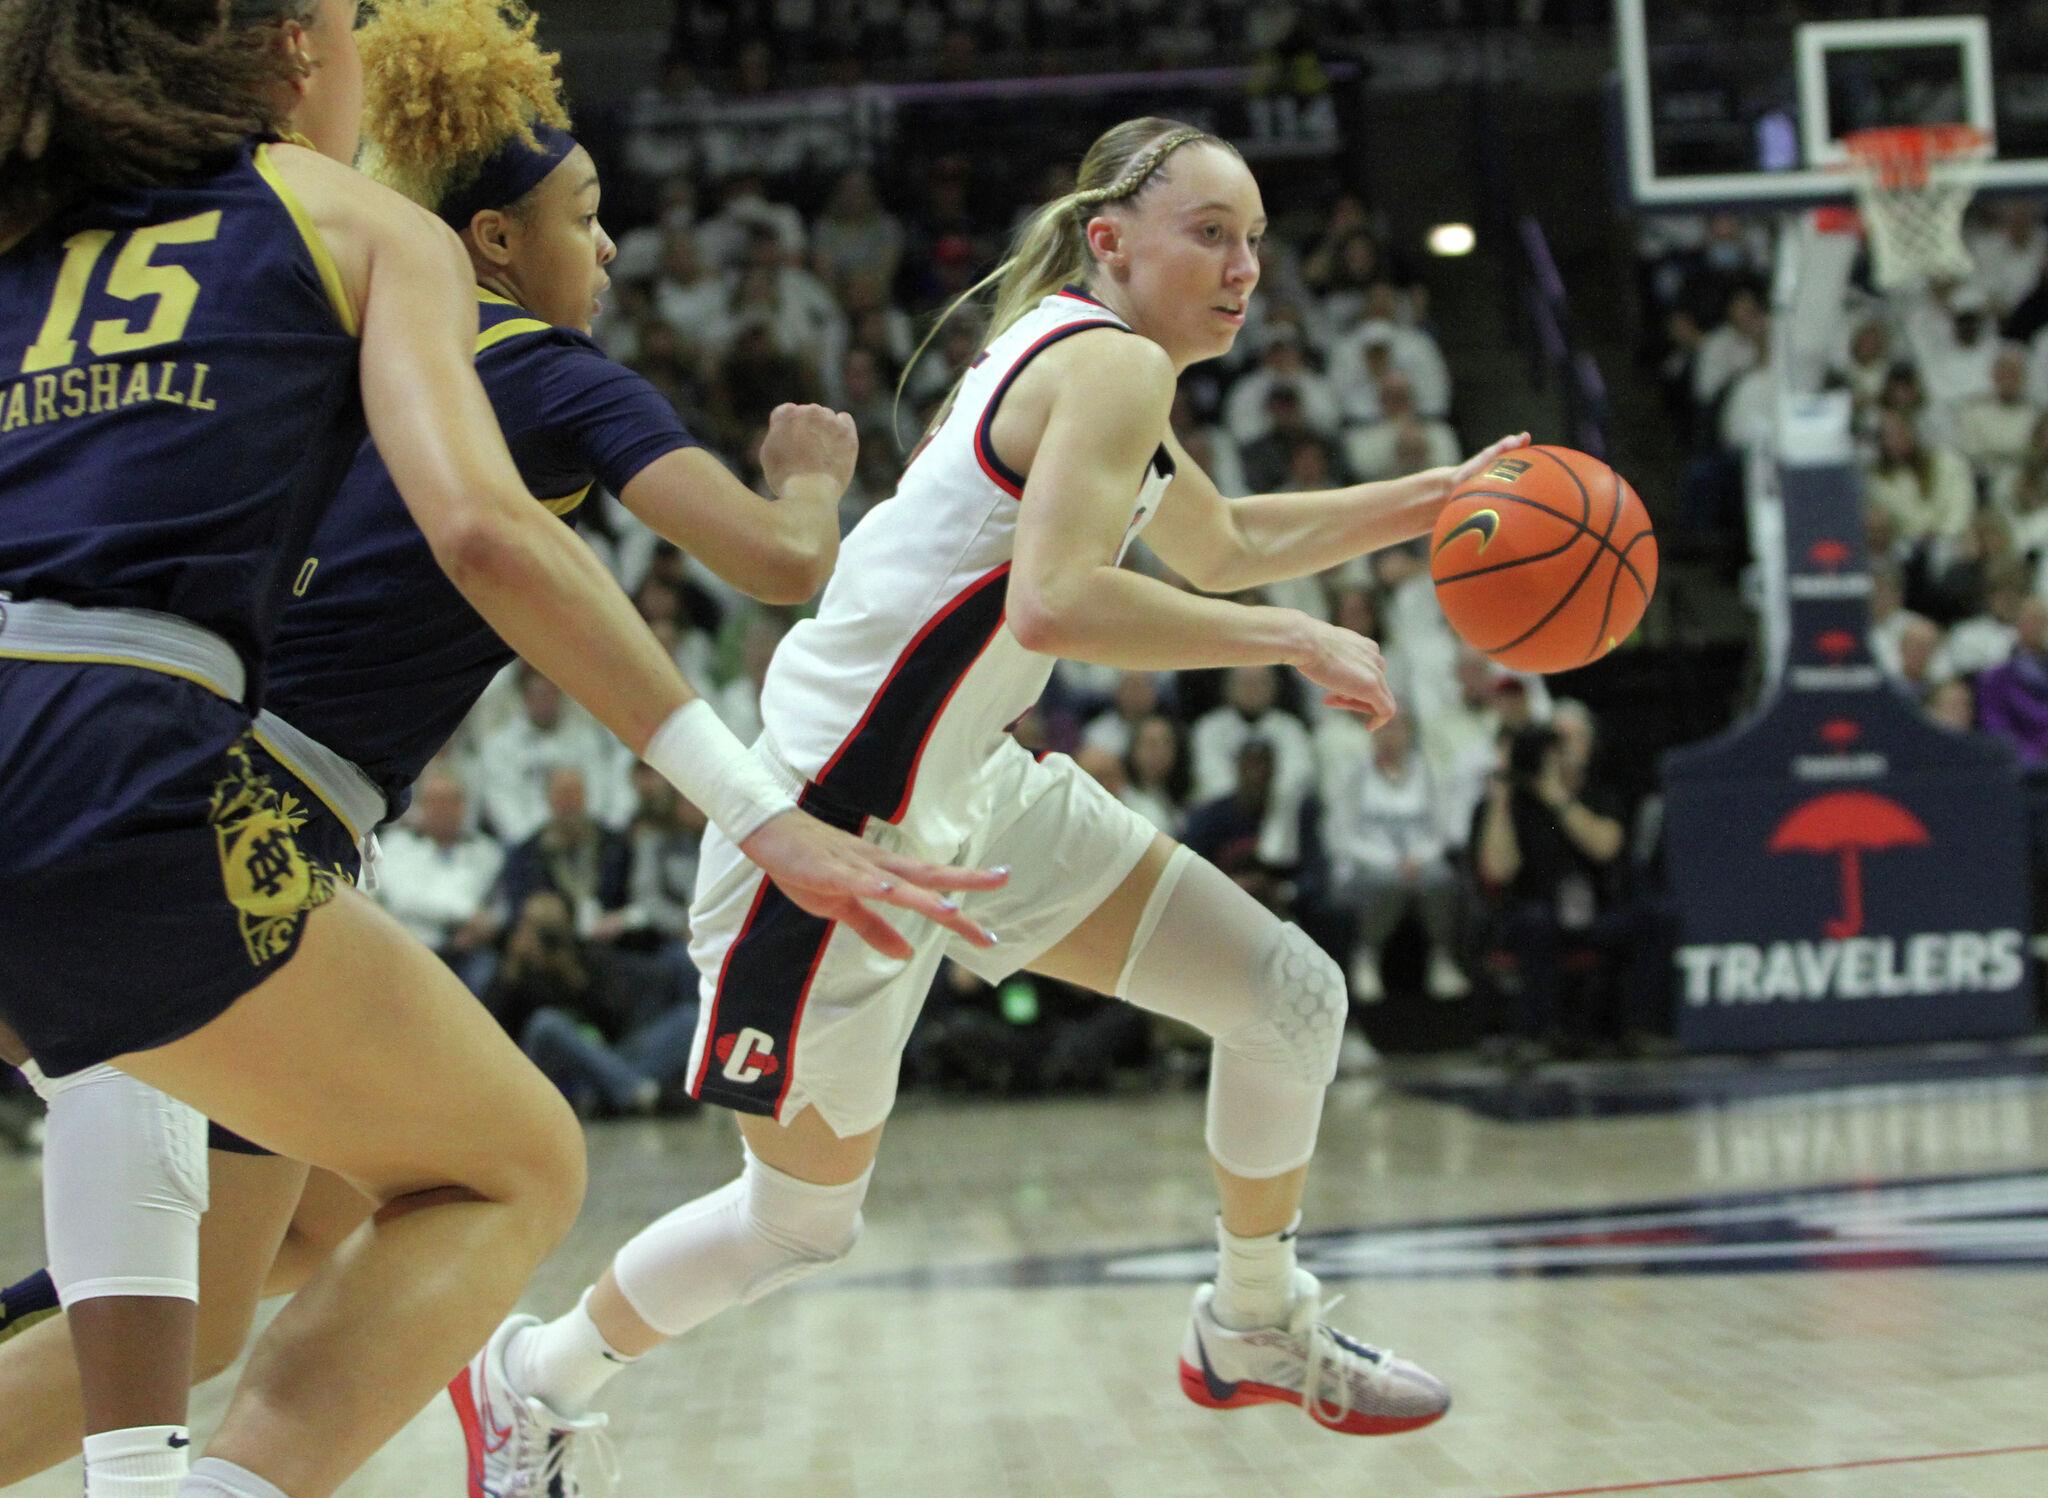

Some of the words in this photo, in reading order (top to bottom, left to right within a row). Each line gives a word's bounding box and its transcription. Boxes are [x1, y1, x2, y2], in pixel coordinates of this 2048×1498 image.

[21, 209, 223, 374] 15
[0, 361, 216, 432] ARSHALL
[1676, 928, 2024, 1006] TRAVELERS
[722, 1026, 775, 1083] C
